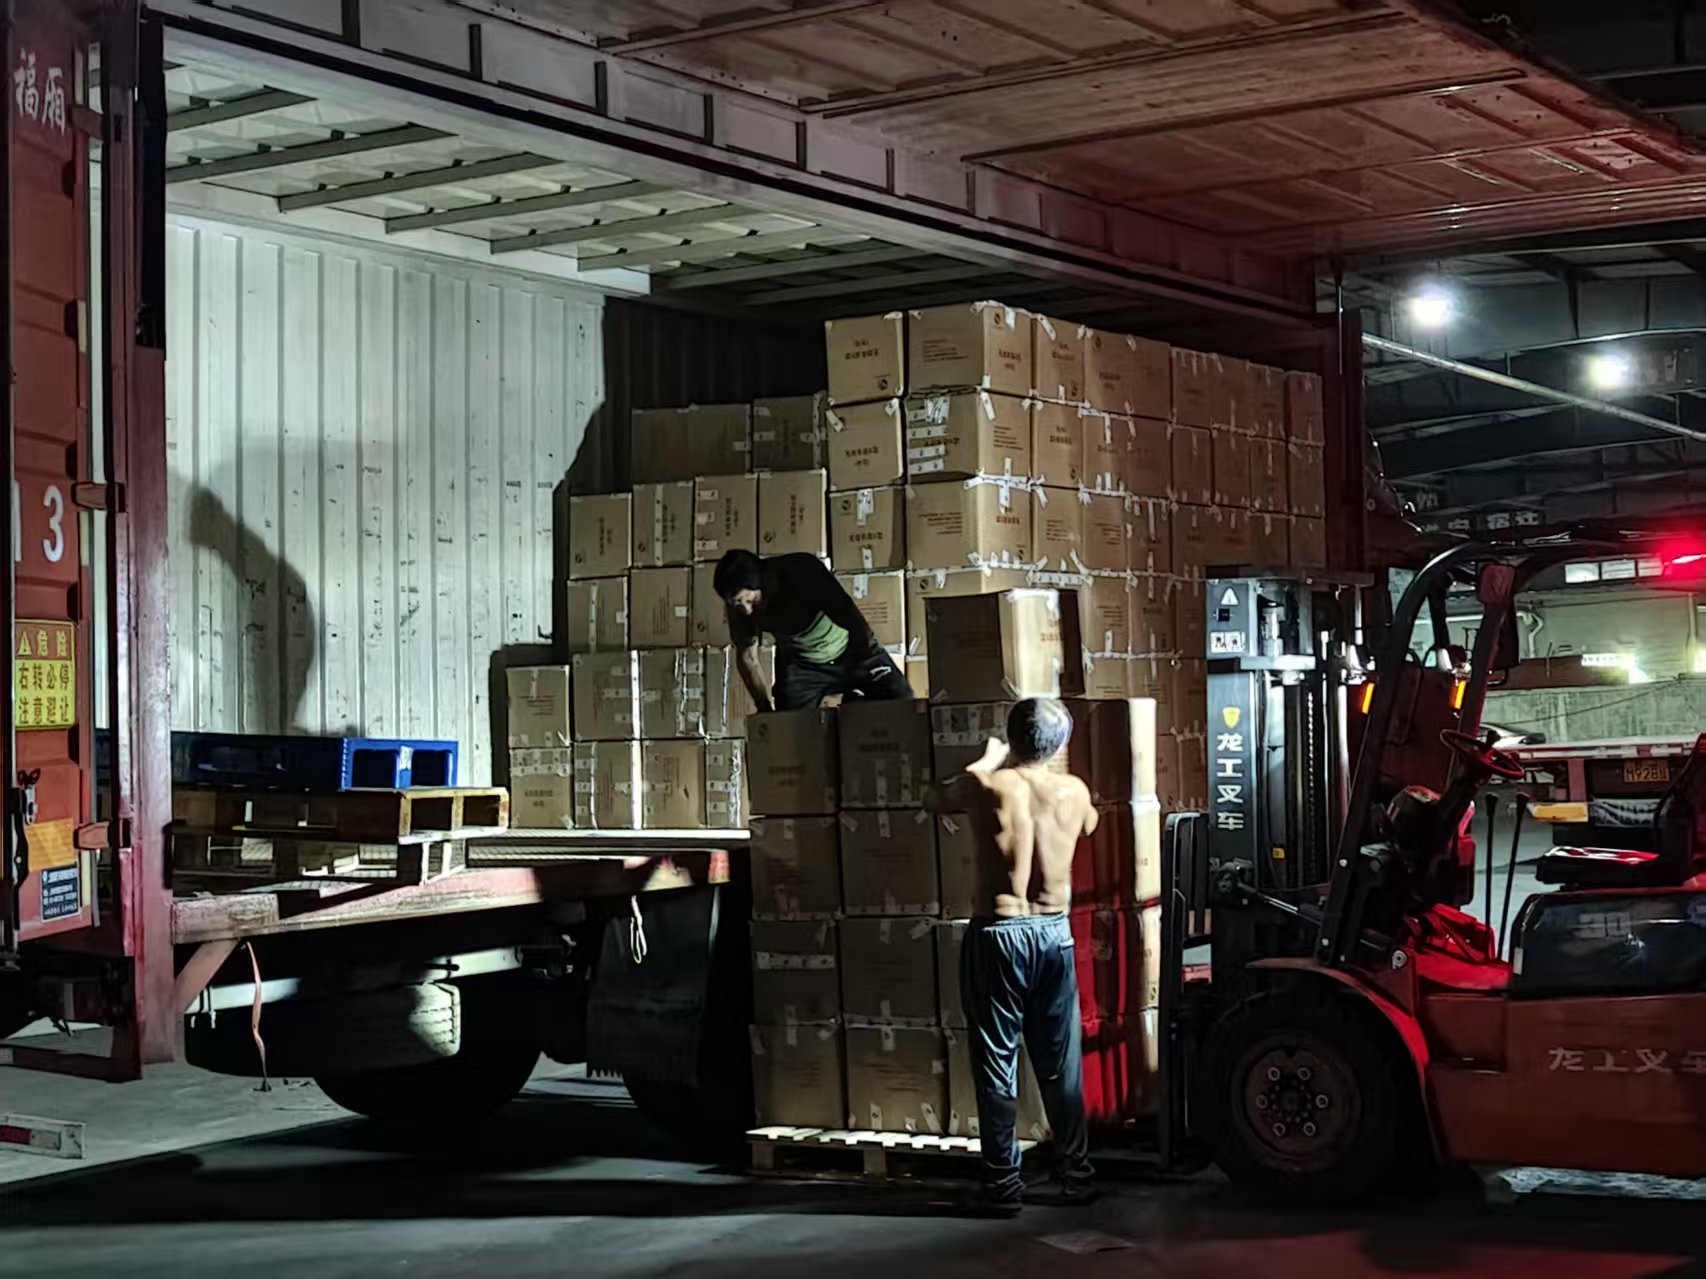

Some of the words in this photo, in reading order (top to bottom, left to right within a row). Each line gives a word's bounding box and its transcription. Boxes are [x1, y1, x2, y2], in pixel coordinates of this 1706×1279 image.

[19, 662, 70, 691] 右转必停
[1216, 732, 1244, 830] 龙工叉车
